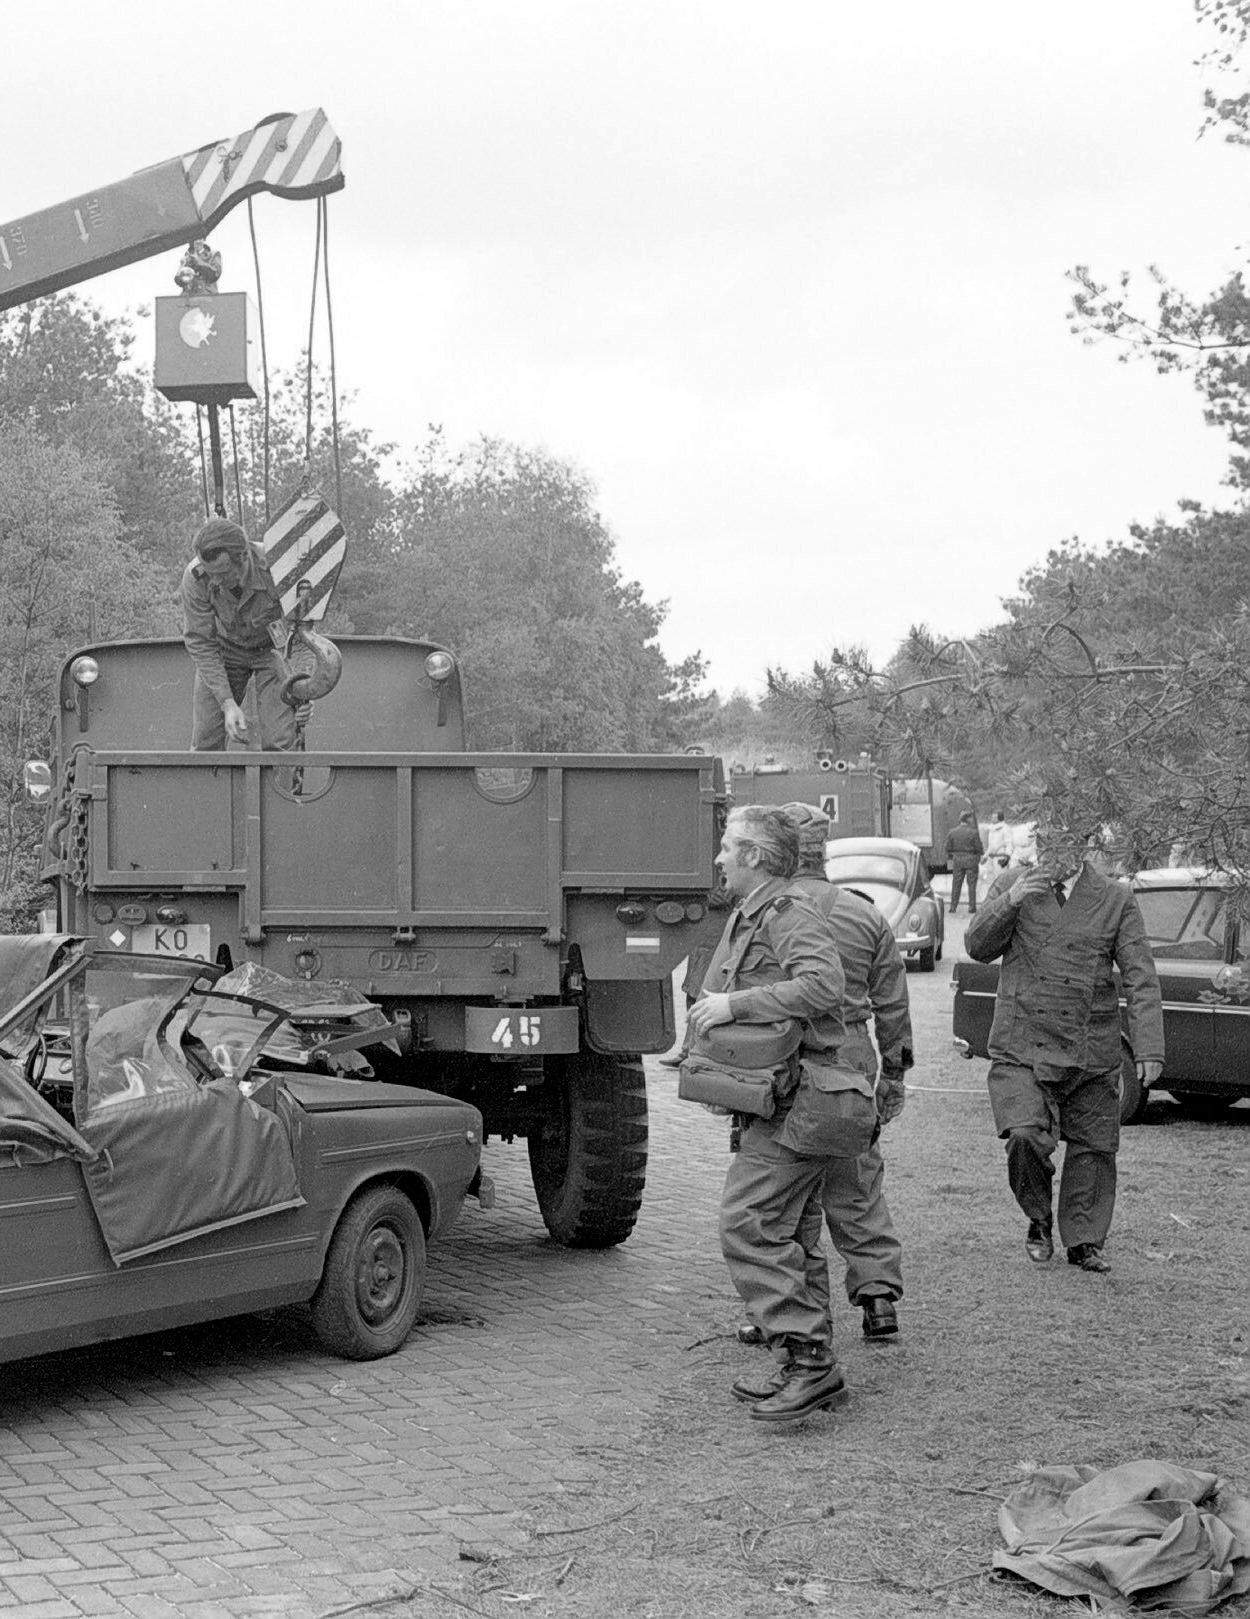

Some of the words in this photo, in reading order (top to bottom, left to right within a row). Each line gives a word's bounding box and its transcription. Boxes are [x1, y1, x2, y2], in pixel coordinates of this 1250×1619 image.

[822, 797, 837, 820] 4
[154, 928, 188, 951] KO
[378, 952, 428, 973] DAF
[491, 1016, 541, 1048] 45
